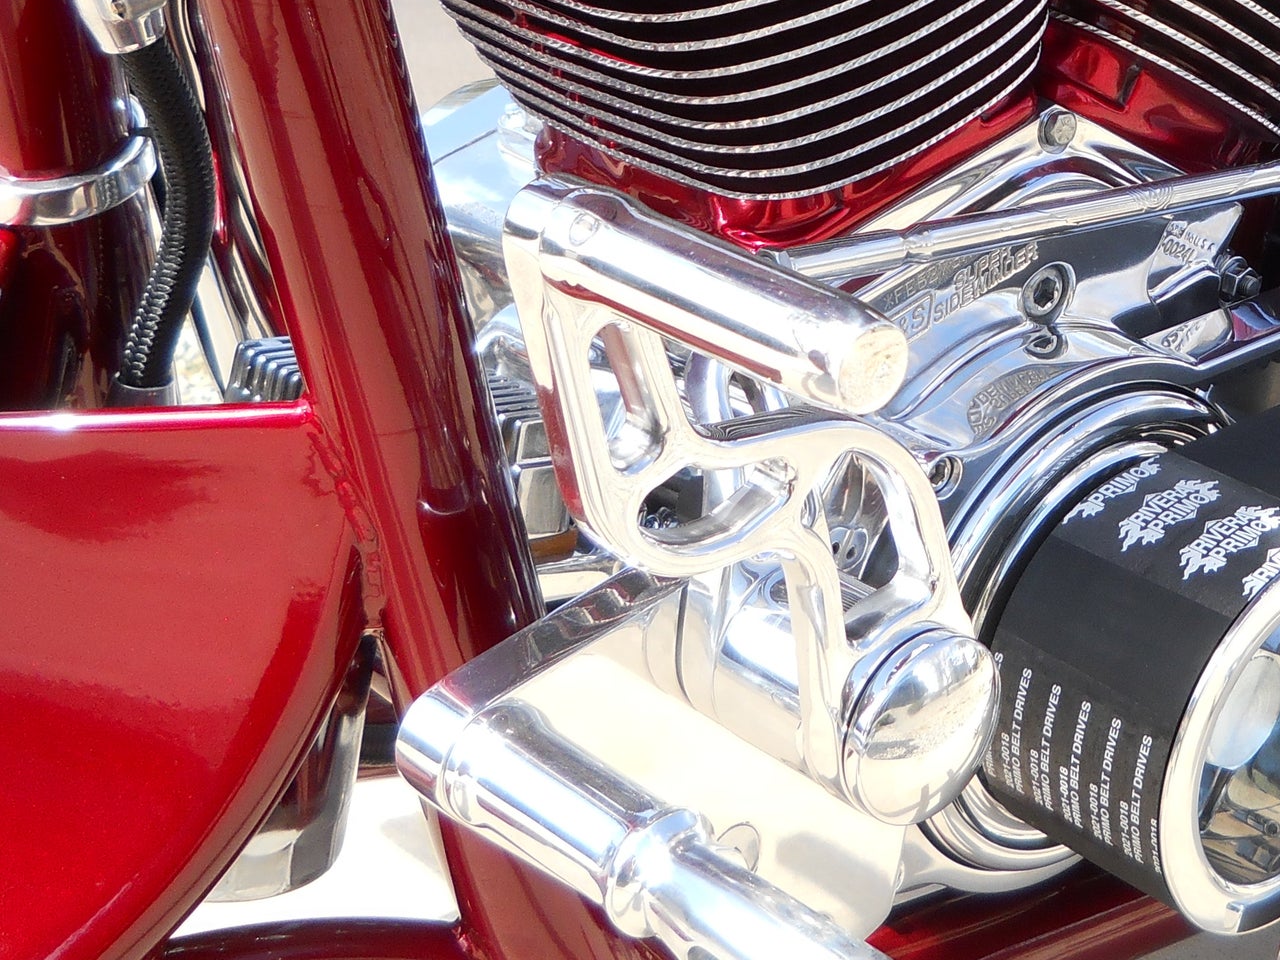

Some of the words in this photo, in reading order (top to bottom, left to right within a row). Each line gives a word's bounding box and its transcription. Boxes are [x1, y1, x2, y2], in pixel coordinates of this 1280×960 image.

[933, 241, 1038, 324] SIDEWINDER
[953, 246, 1012, 290] SUPER
[1088, 467, 1149, 506] PRIMO
[1129, 484, 1195, 527] RIVERA
[1147, 493, 1209, 534] PRIMO
[1190, 511, 1256, 555] RIVERA
[1208, 520, 1271, 561] PRIMO
[1013, 668, 1032, 720] DRIVES
[1043, 684, 1062, 737] DRIVES
[1011, 721, 1021, 755] BELT
[1072, 701, 1091, 754] DRIVES
[1103, 717, 1121, 772] DRIVES
[1001, 732, 1014, 788] 2021-0018
[1011, 757, 1025, 794] PRIMO
[1040, 737, 1050, 772] BELT
[1070, 754, 1080, 790] BELT
[1133, 735, 1153, 789] DRIVES
[1030, 749, 1043, 805] 2021-0018
[1041, 774, 1054, 811] PRIMO
[1060, 766, 1073, 823] 2021-0018
[1100, 771, 1110, 807] BELT
[1070, 791, 1083, 829] PRIMO
[1089, 783, 1102, 840] 2021-0018
[1100, 809, 1113, 846] PRIMO
[1130, 789, 1140, 825] BELT
[1120, 801, 1133, 858] 2021-0018
[1131, 826, 1144, 864] PRIMO
